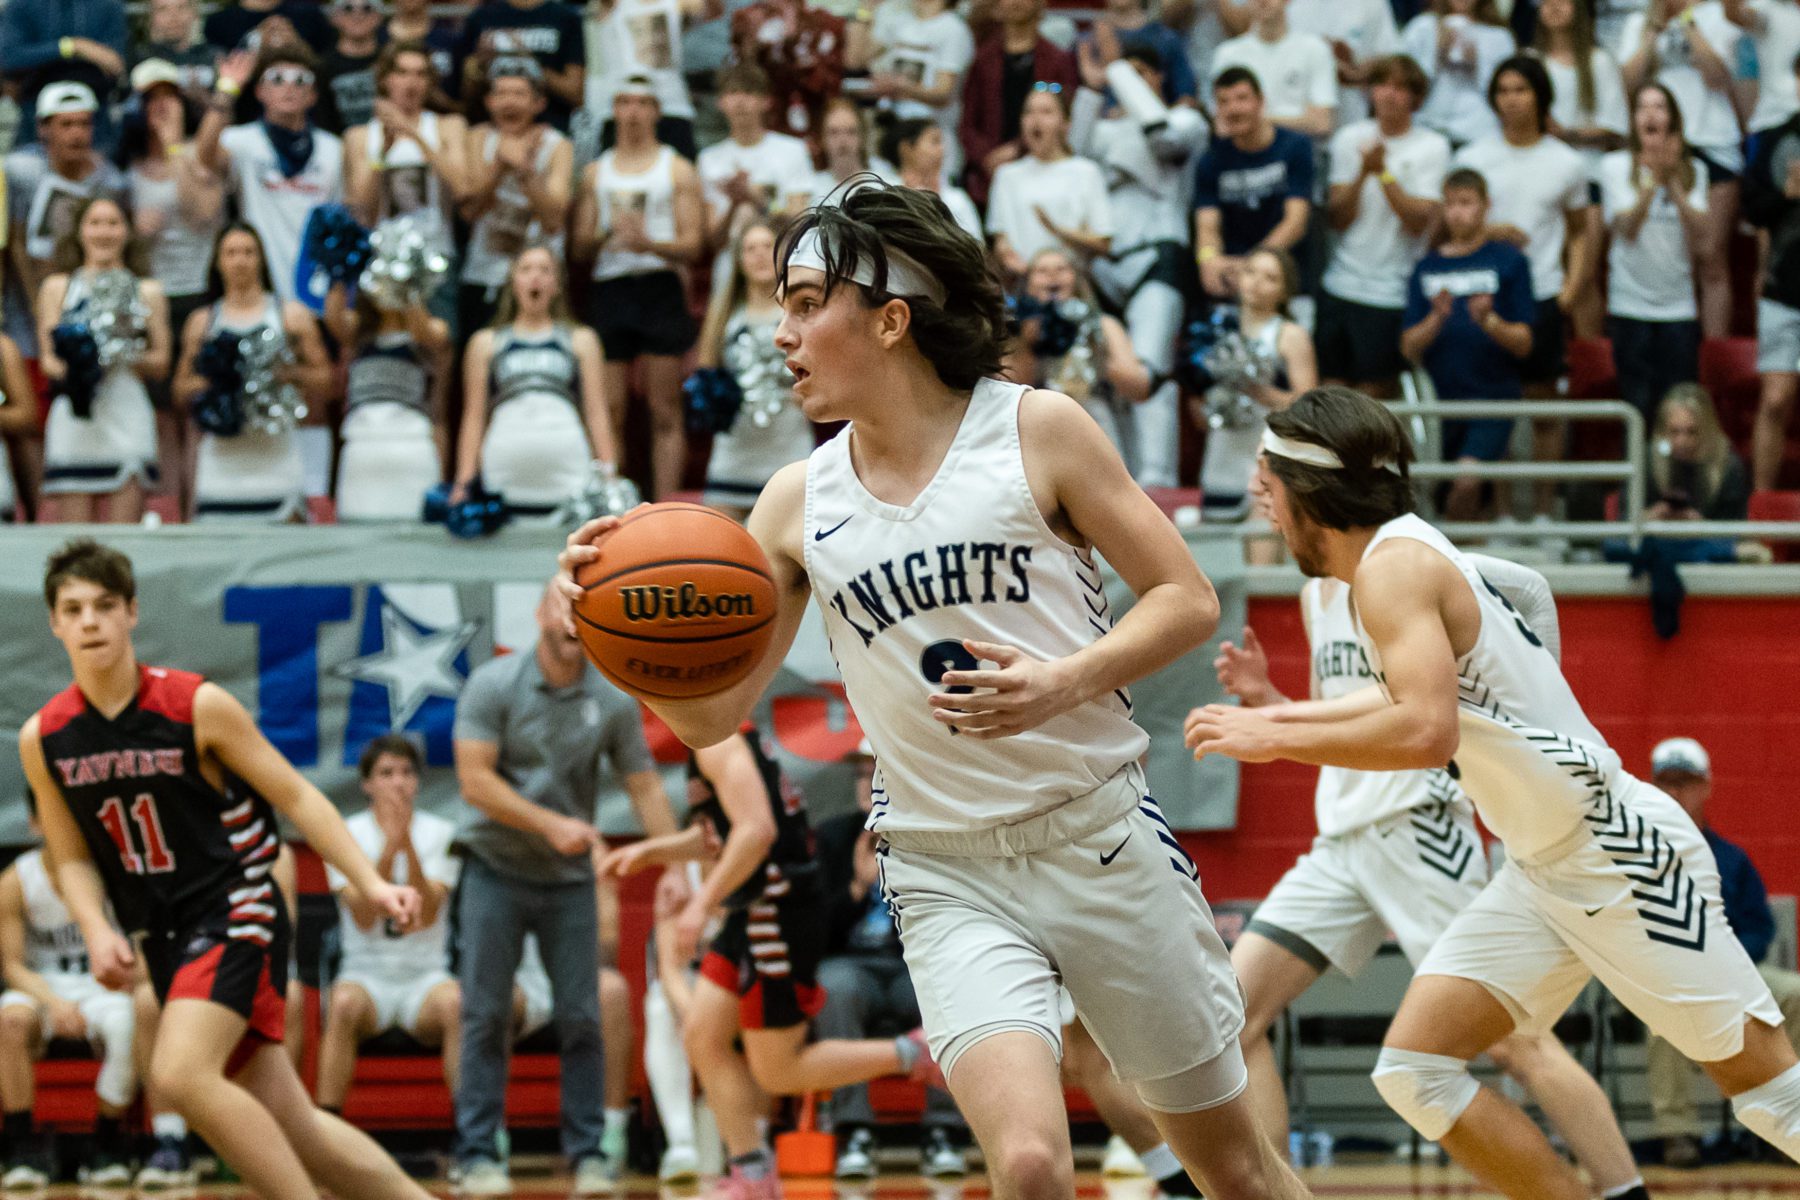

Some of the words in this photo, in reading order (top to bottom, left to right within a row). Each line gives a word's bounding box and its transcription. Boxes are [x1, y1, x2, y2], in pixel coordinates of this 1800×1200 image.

[619, 582, 755, 622] Wilson
[829, 541, 1033, 648] KNIGHTS
[96, 793, 177, 874] 11
